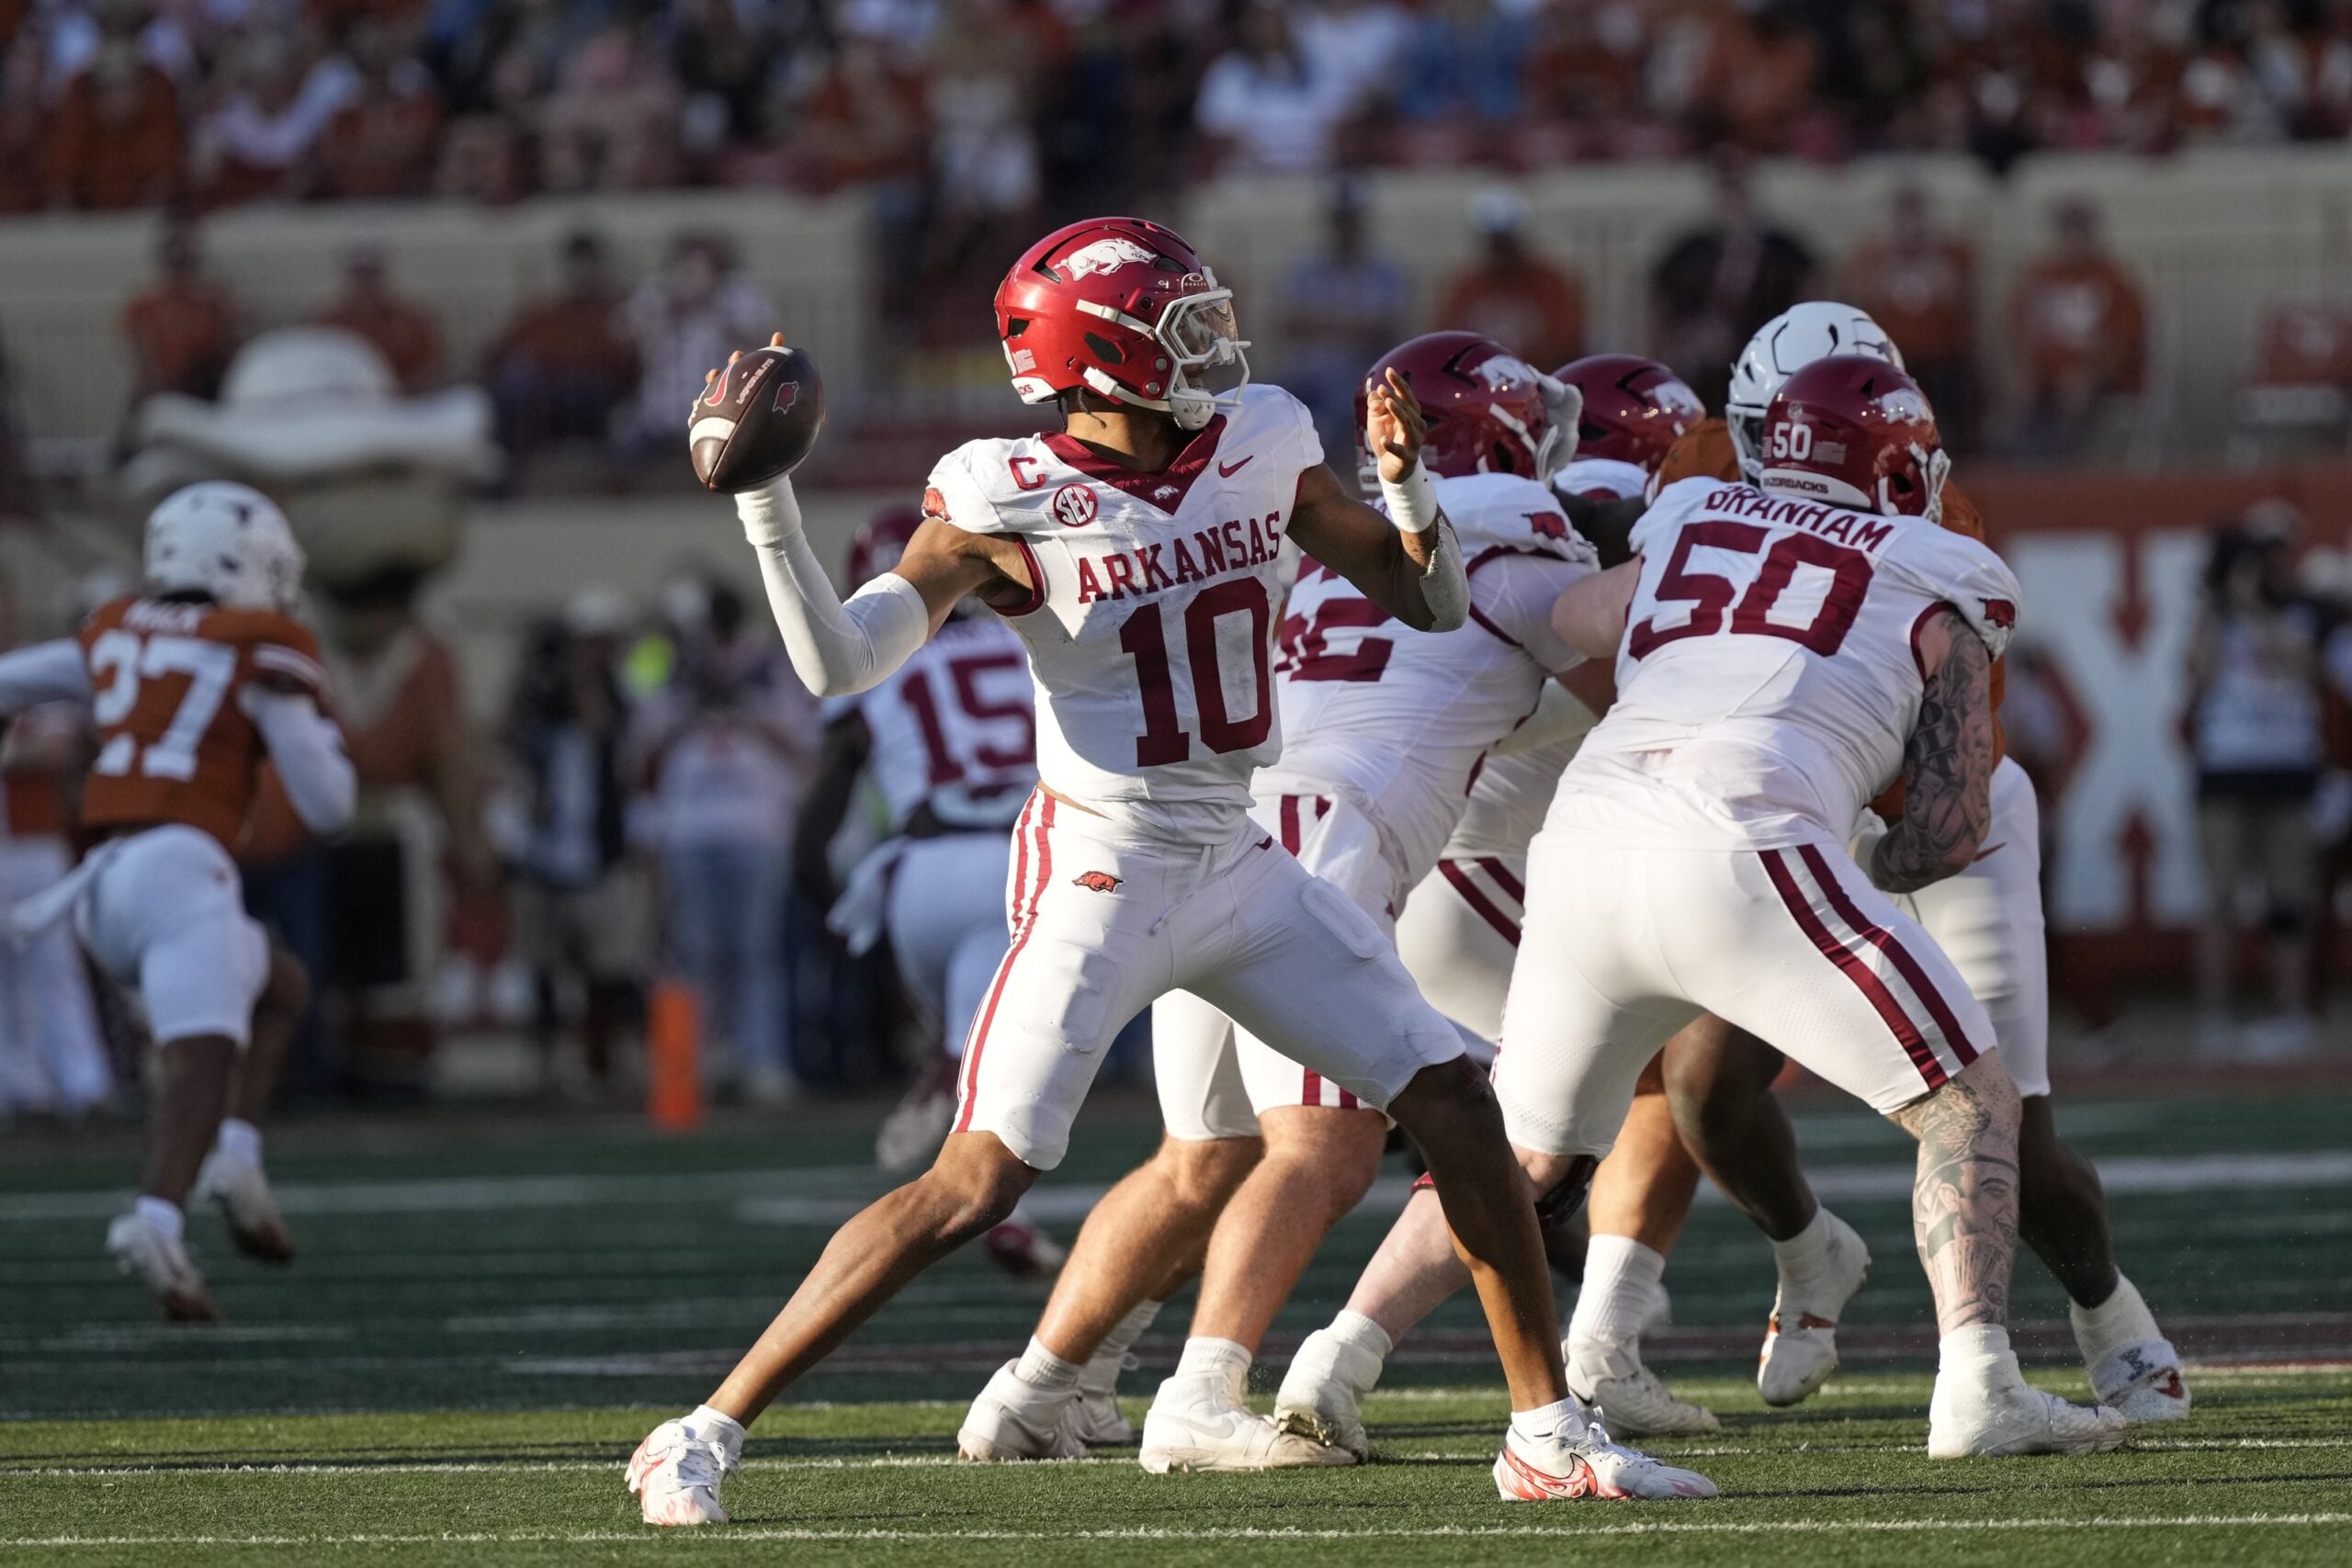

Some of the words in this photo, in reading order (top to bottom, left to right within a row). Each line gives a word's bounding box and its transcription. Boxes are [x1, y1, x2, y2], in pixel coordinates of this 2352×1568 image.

[1008, 457, 1046, 491] C
[1772, 422, 1812, 460] 50
[1057, 487, 1096, 525] SEC
[1705, 486, 1894, 553] BRANHAM
[1764, 477, 1828, 493] ZORBACKS
[1078, 511, 1281, 604] ARKANSAS
[1629, 520, 1875, 662] 50
[91, 627, 239, 784] 27
[1119, 576, 1272, 768] 10
[900, 653, 1036, 785] 15
